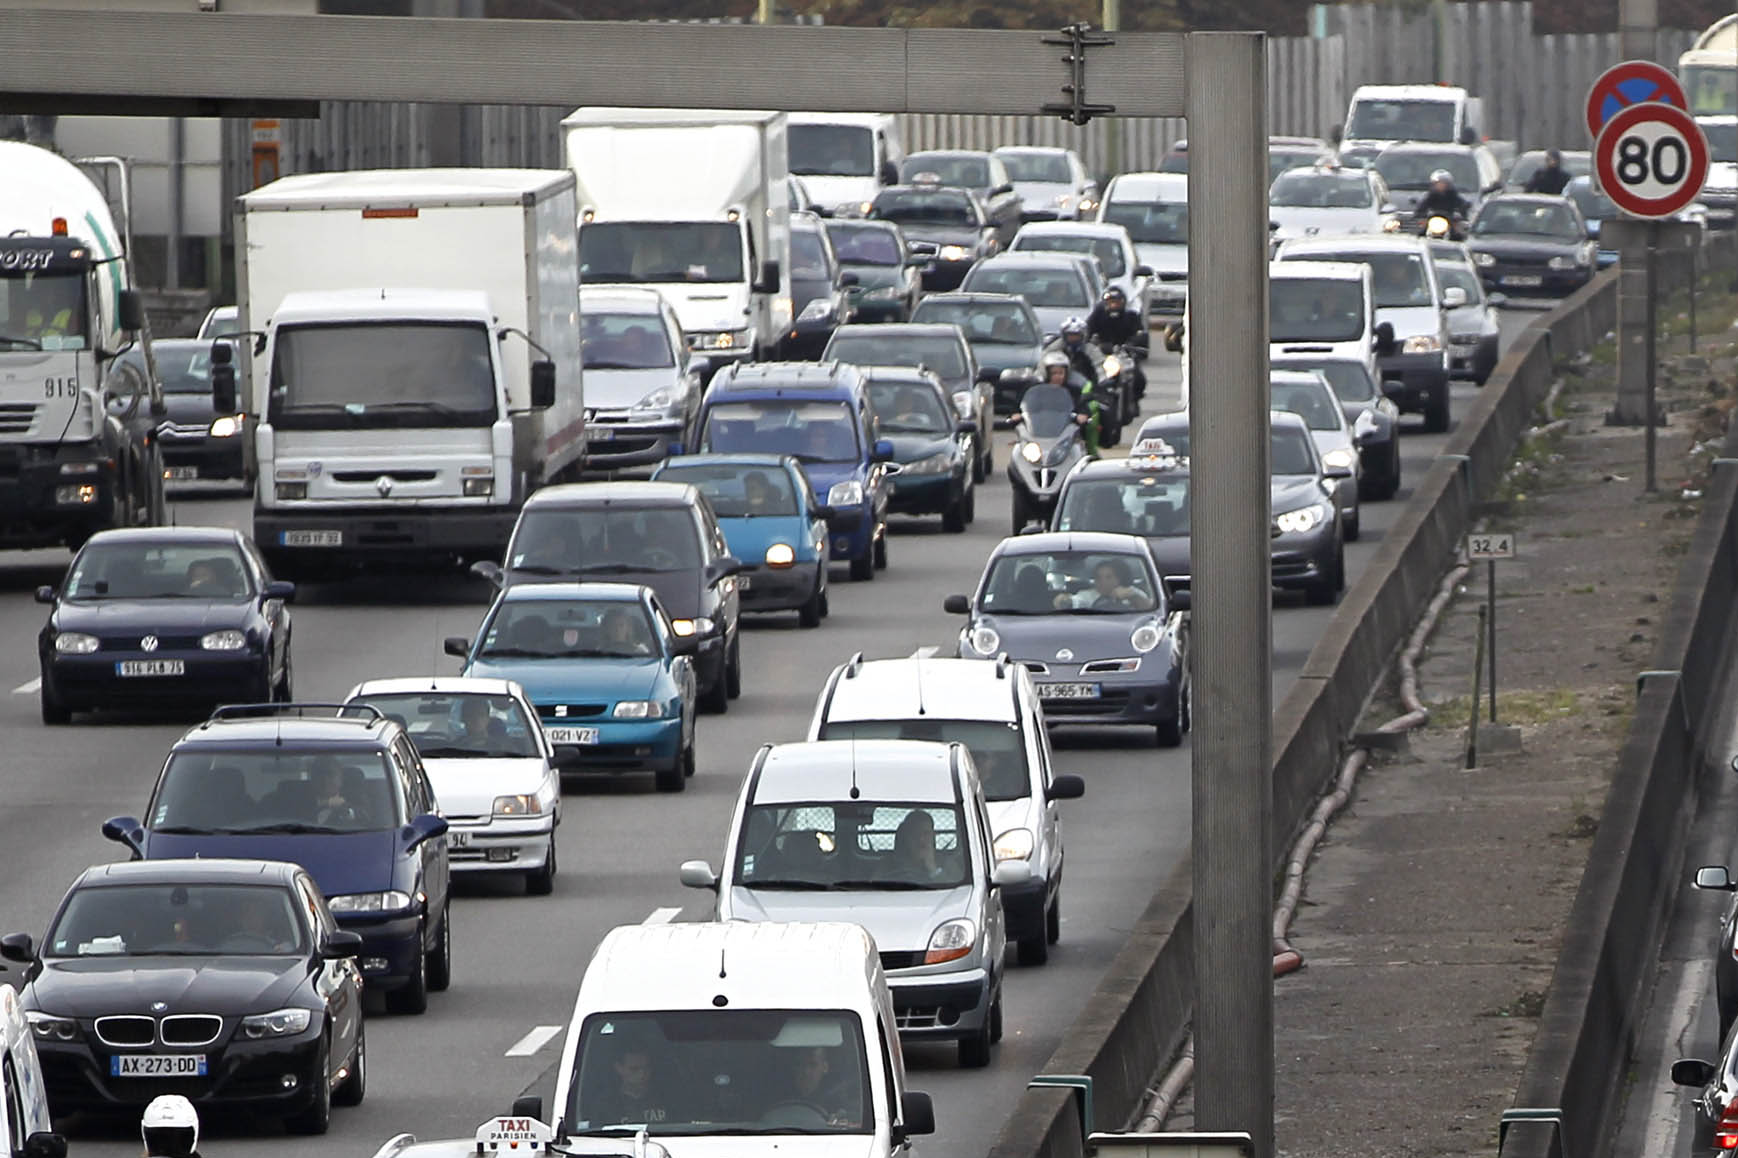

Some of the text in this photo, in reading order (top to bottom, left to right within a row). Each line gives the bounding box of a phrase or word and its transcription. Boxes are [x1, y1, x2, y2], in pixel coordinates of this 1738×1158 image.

[1618, 136, 1687, 186] 80
[0, 251, 54, 269] ORT
[46, 377, 77, 399] 915
[122, 1058, 197, 1074] AX-273-DD
[499, 1120, 530, 1132] TAXI
[491, 1132, 537, 1140] PARISIEN
